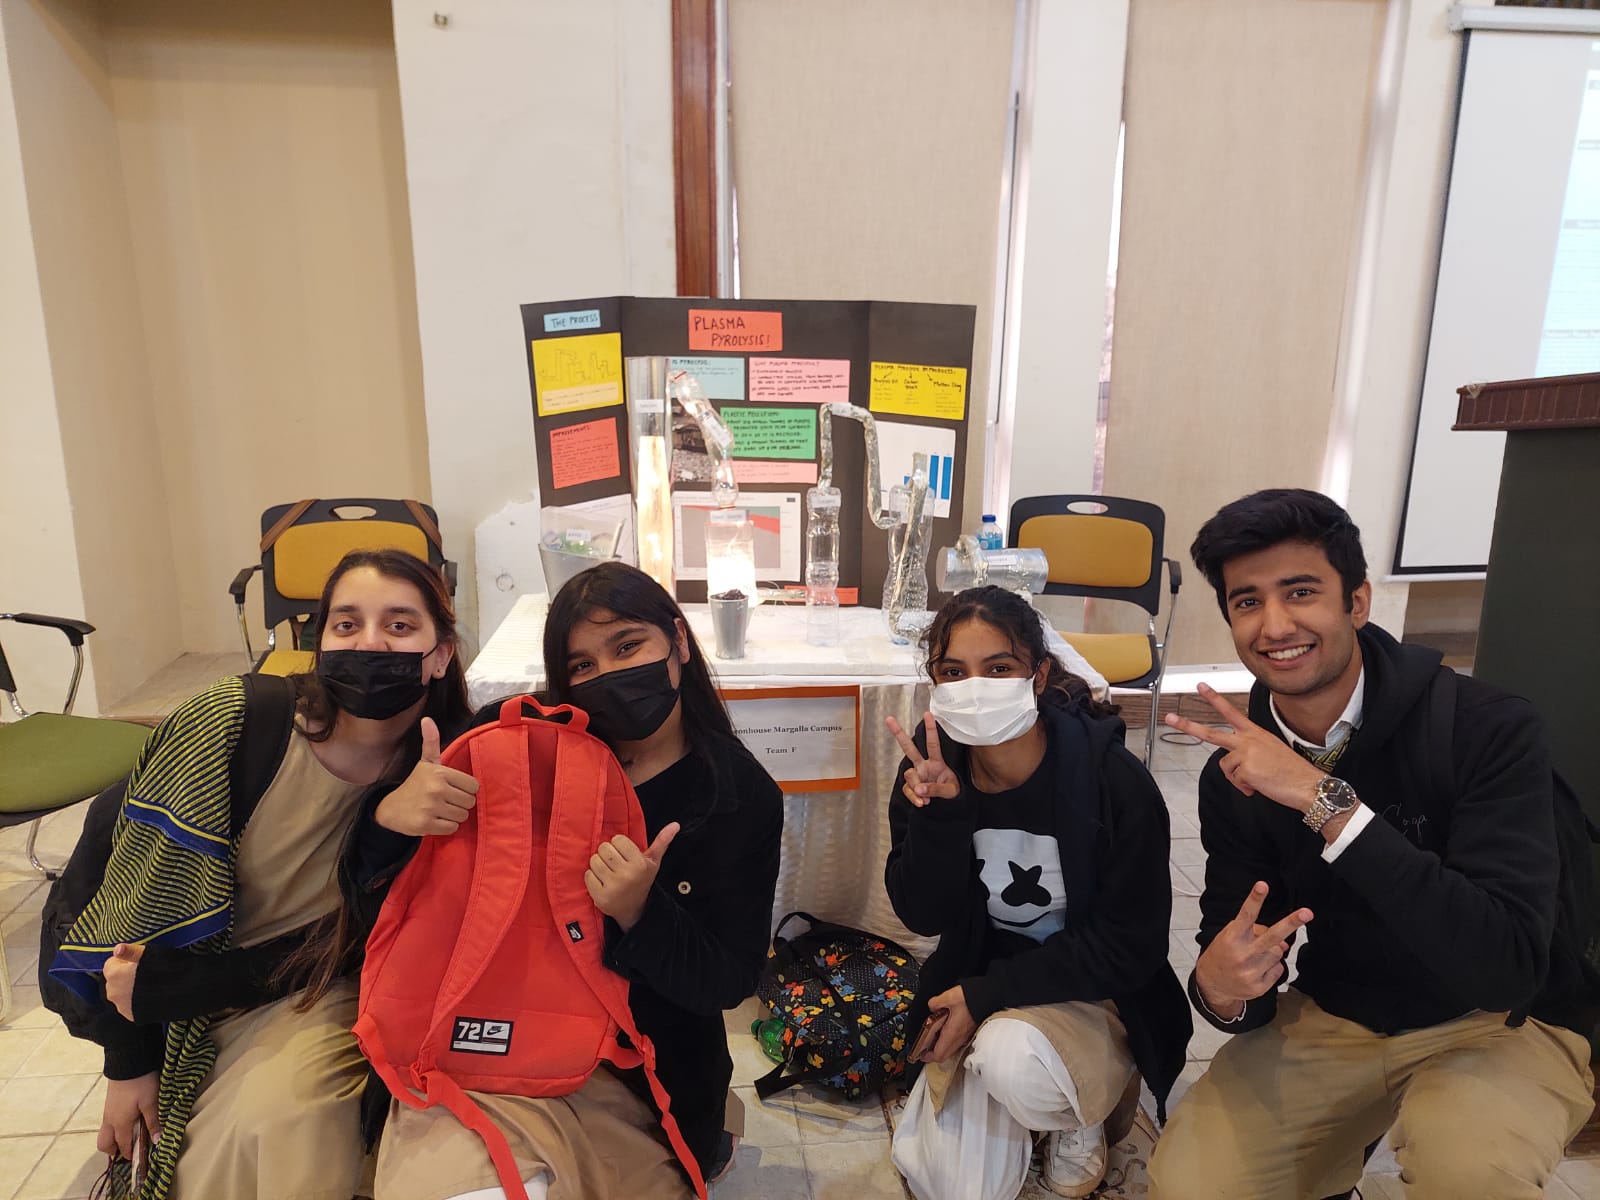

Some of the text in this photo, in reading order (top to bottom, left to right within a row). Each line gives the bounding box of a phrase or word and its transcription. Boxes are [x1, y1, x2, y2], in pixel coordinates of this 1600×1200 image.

[551, 312, 599, 328] THE PROCESS
[694, 316, 746, 331] PLASMA
[711, 333, 772, 348] PYROLYSIS!
[773, 725, 809, 735] Margalla
[810, 725, 843, 733] Campus
[458, 1021, 481, 1040] 72
